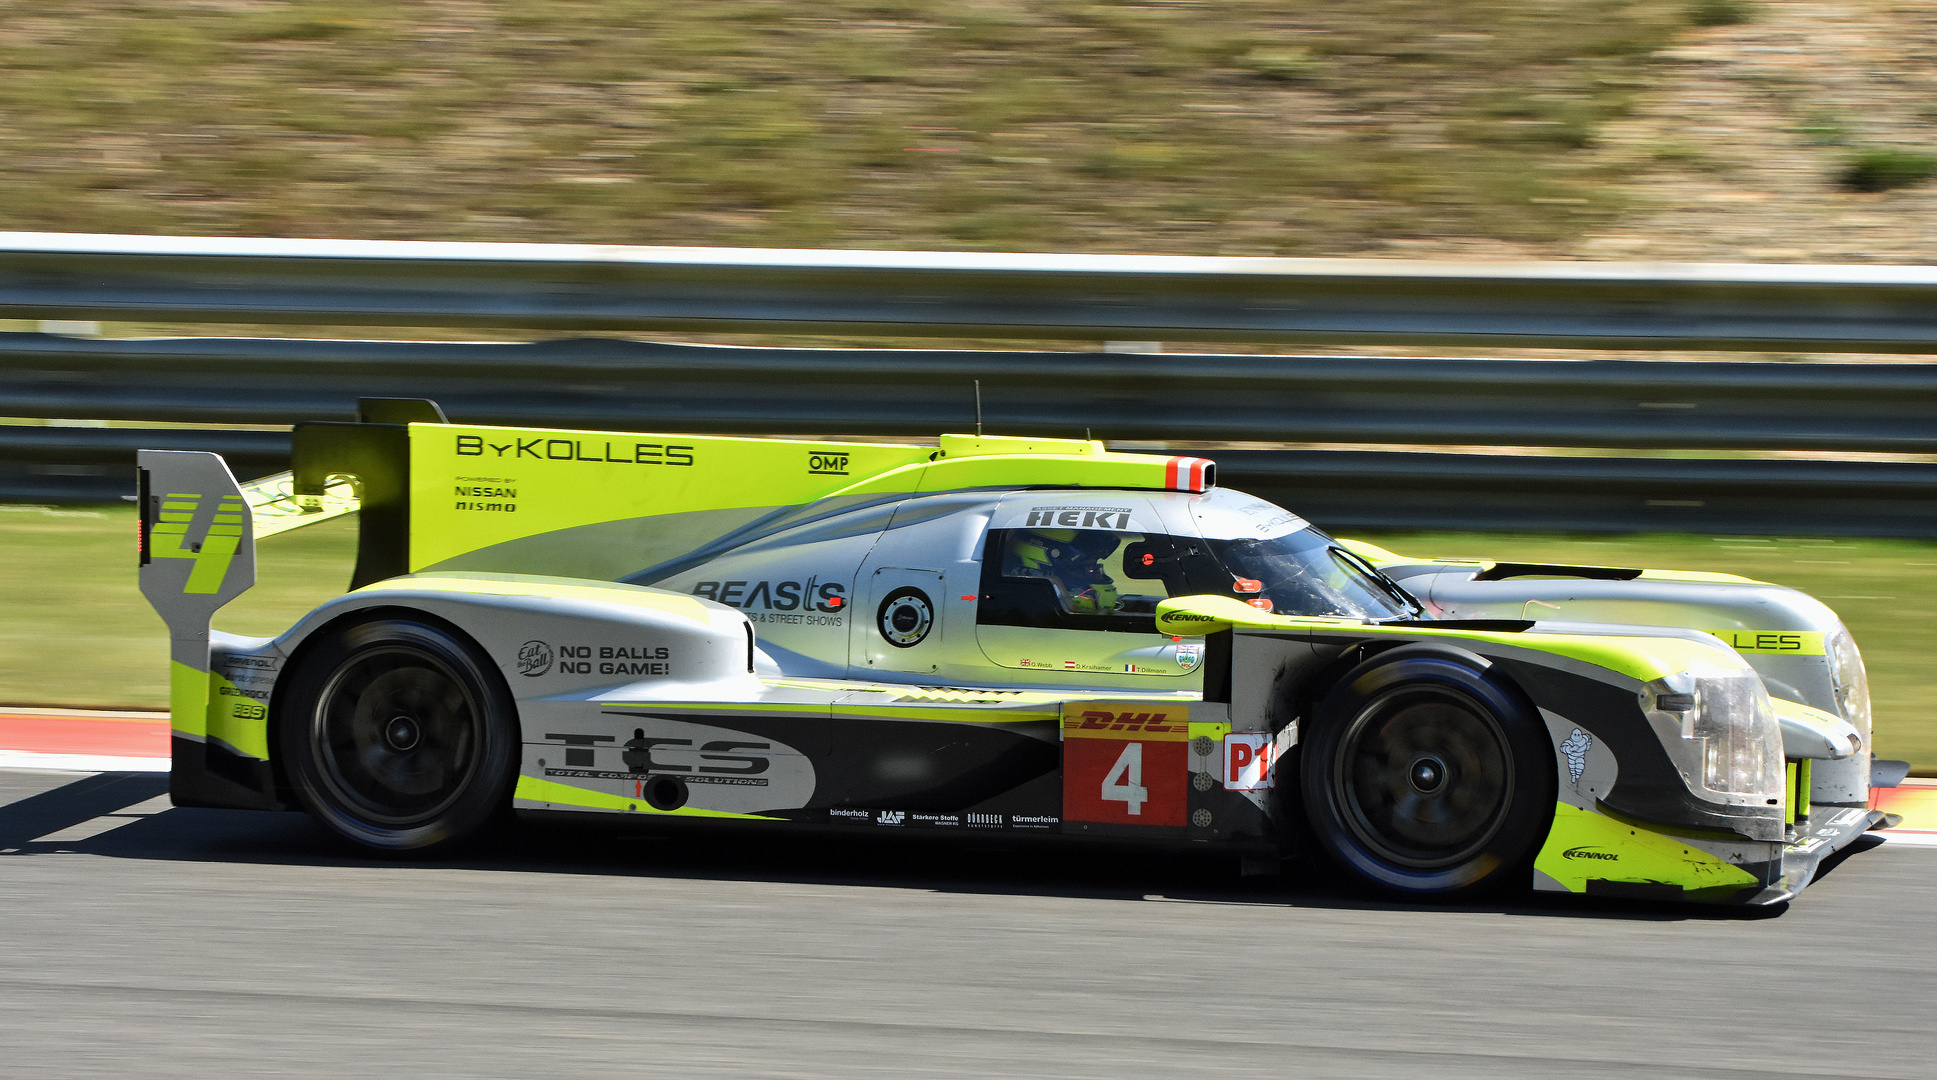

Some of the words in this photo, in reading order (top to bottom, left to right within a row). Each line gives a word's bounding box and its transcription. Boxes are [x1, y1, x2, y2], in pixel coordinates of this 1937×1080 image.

[809, 455, 849, 471] OMP
[455, 475, 501, 483] POWERED
[455, 486, 517, 498] NISSAN
[455, 501, 516, 512] nismo
[1026, 511, 1131, 530] HEKI
[150, 493, 243, 595] 4
[759, 613, 767, 623] &
[769, 613, 804, 625] STREET
[806, 615, 843, 627] SHOWS
[1163, 613, 1215, 622] KENNOL
[518, 644, 542, 660] Eat
[560, 646, 591, 658] NO
[600, 647, 669, 660] BALLS
[520, 653, 549, 674] Ball
[560, 662, 591, 674] NO
[600, 662, 669, 675] GAME!
[233, 703, 266, 720] BBS
[1079, 711, 1172, 732] DHL
[545, 733, 770, 775] TCS
[1229, 743, 1268, 782] P1
[547, 769, 594, 778] TOTAL
[684, 775, 768, 786] SOLUTIONS
[1101, 742, 1148, 815] 4
[830, 809, 869, 818] binderholz
[877, 810, 905, 824] JAF
[1012, 815, 1059, 823] türmerleim
[1566, 850, 1618, 861] KENNOL
